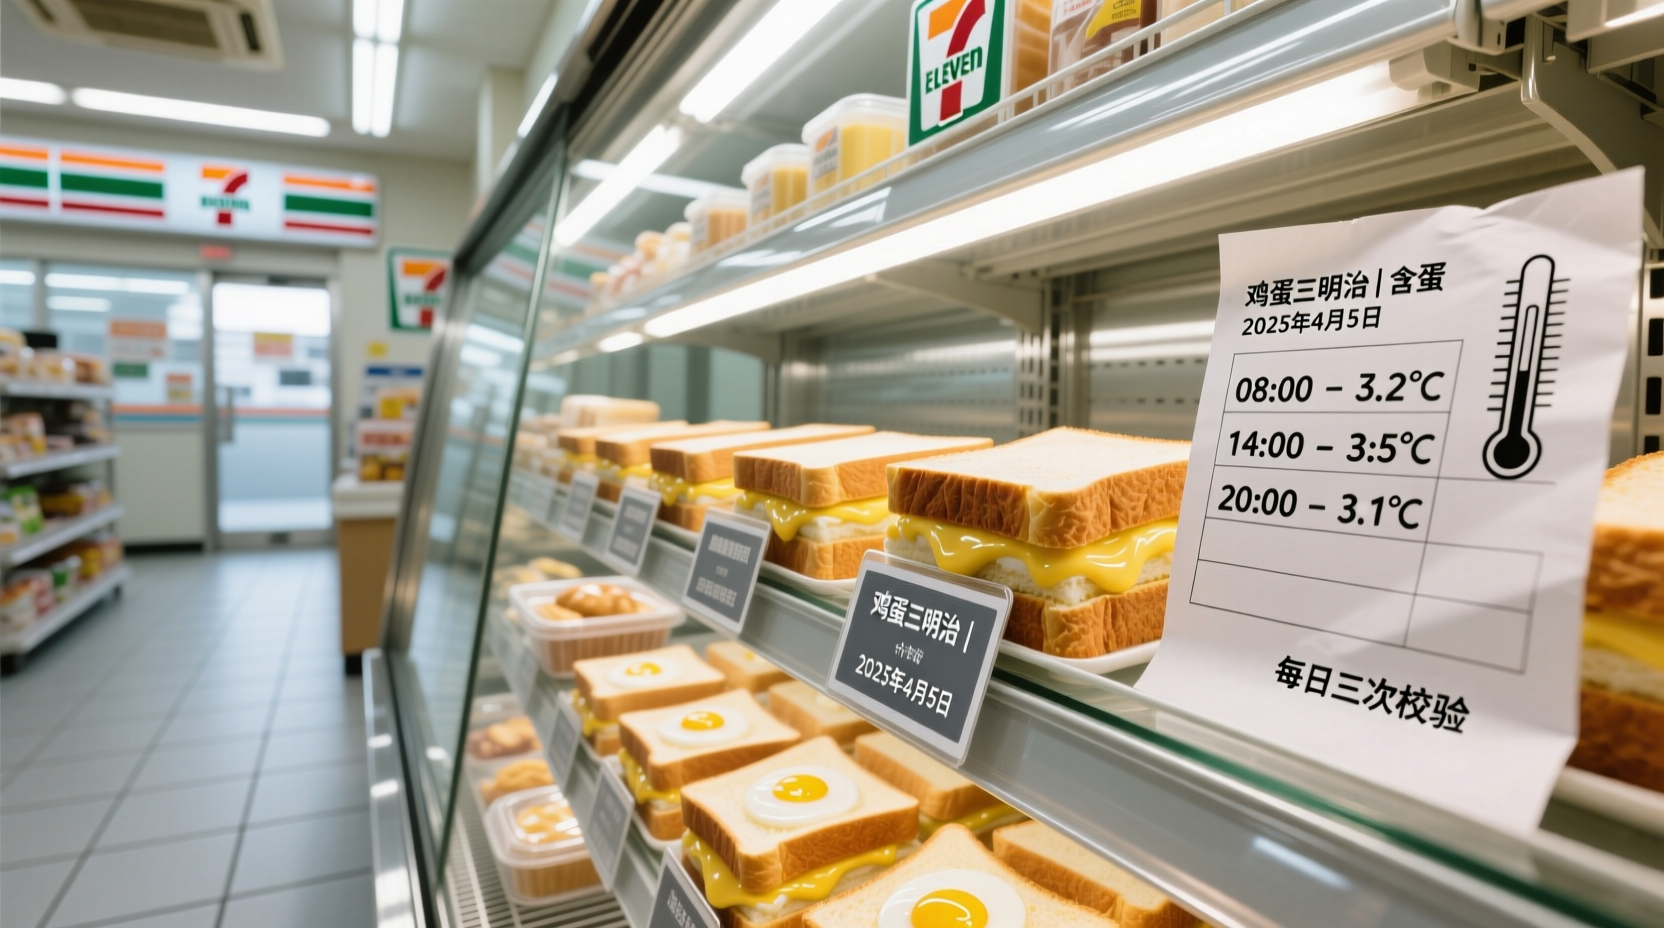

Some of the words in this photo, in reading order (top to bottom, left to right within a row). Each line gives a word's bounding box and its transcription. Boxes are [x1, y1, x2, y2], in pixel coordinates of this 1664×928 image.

[1245, 270, 1369, 307] 鸡蛋三明治
[1390, 262, 1447, 295] 含蛋
[1242, 306, 1382, 336] 2025年4月5日
[1235, 375, 1313, 403] 08:00
[1355, 370, 1445, 402] 3.2°C
[1229, 430, 1304, 459] 14:00
[1218, 484, 1297, 517] 20:00
[1337, 493, 1423, 529] 3.1°C
[870, 590, 960, 647] 鸡蛋三明治
[855, 654, 953, 718] 2025年4月5日
[1275, 655, 1470, 733] 每日三次校验
